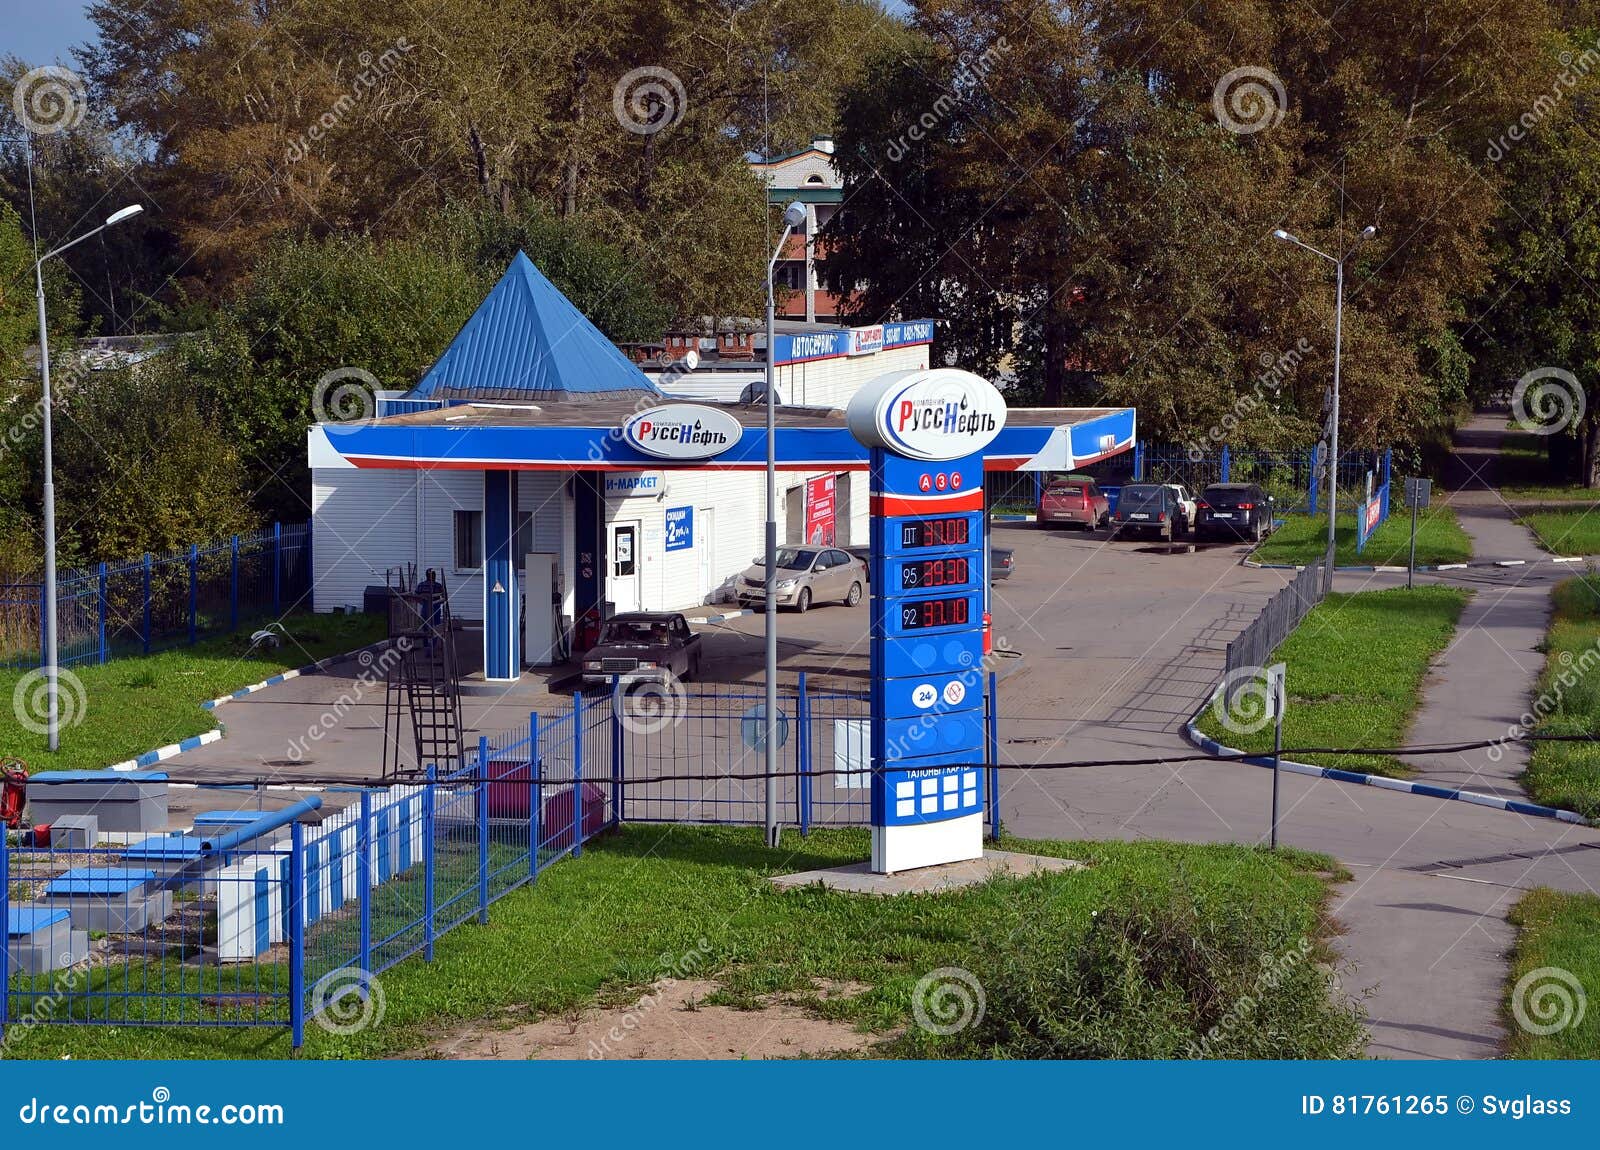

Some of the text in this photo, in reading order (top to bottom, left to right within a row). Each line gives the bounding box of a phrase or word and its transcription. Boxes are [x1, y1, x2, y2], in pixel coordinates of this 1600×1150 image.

[791, 334, 834, 358] АВТОСЕРВИС
[668, 521, 676, 542] 2
[903, 527, 917, 545] ДТ
[903, 567, 918, 585] 95
[903, 608, 917, 625] 92
